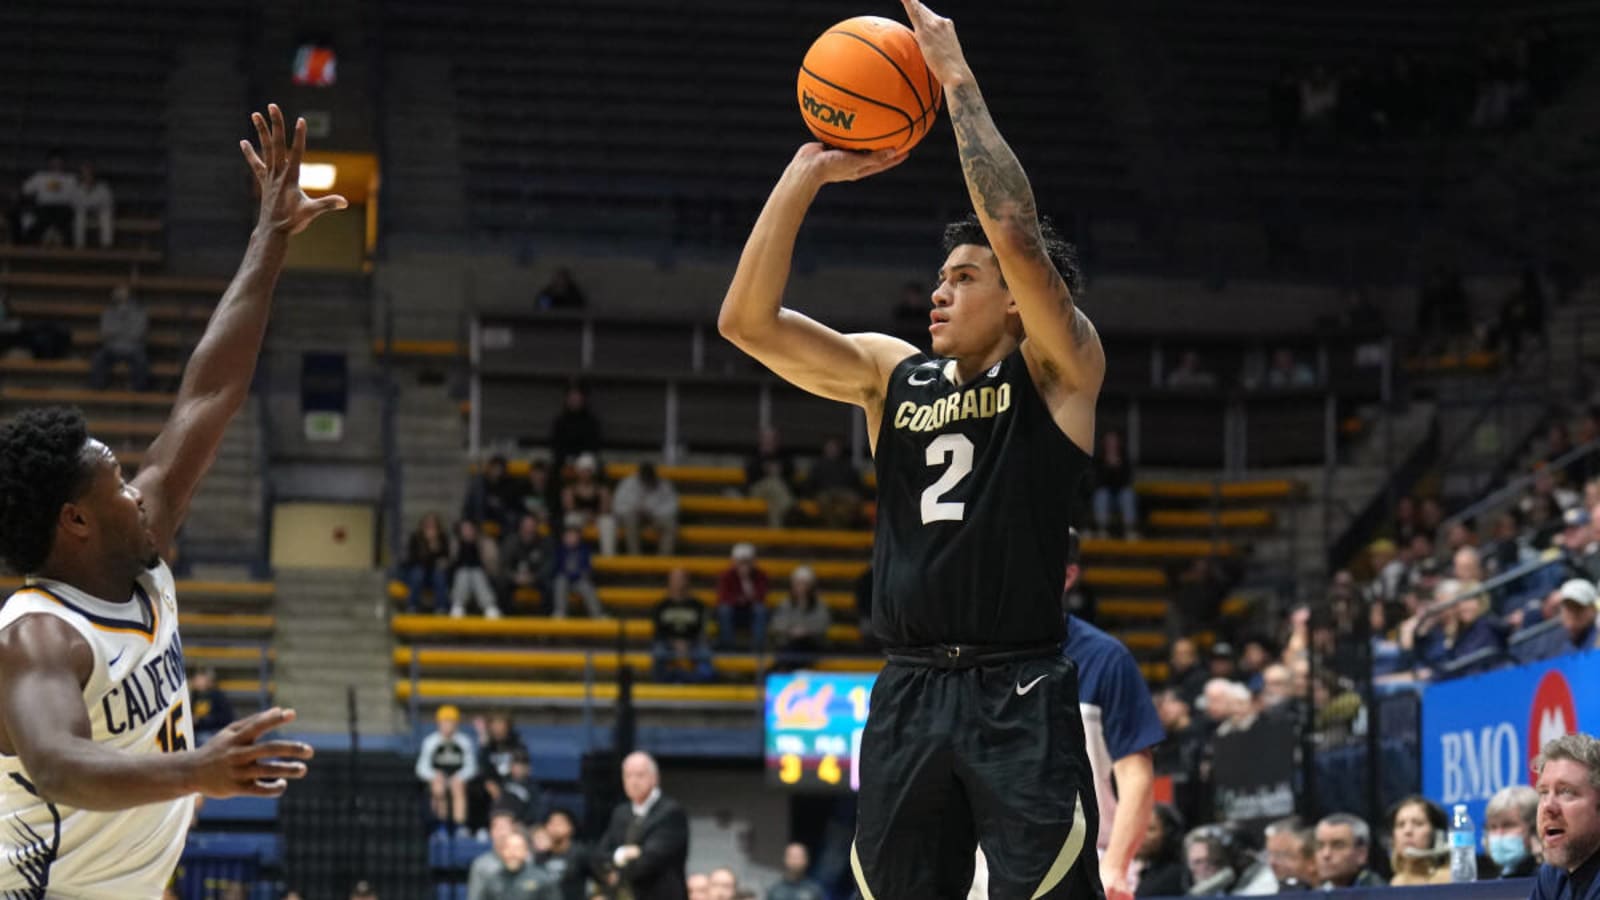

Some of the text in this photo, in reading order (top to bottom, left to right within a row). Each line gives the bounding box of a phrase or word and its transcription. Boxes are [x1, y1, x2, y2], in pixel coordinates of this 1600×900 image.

[802, 90, 856, 131] NCAA
[920, 432, 975, 525] 2
[779, 753, 802, 785] 3
[1440, 722, 1520, 804] BMO
